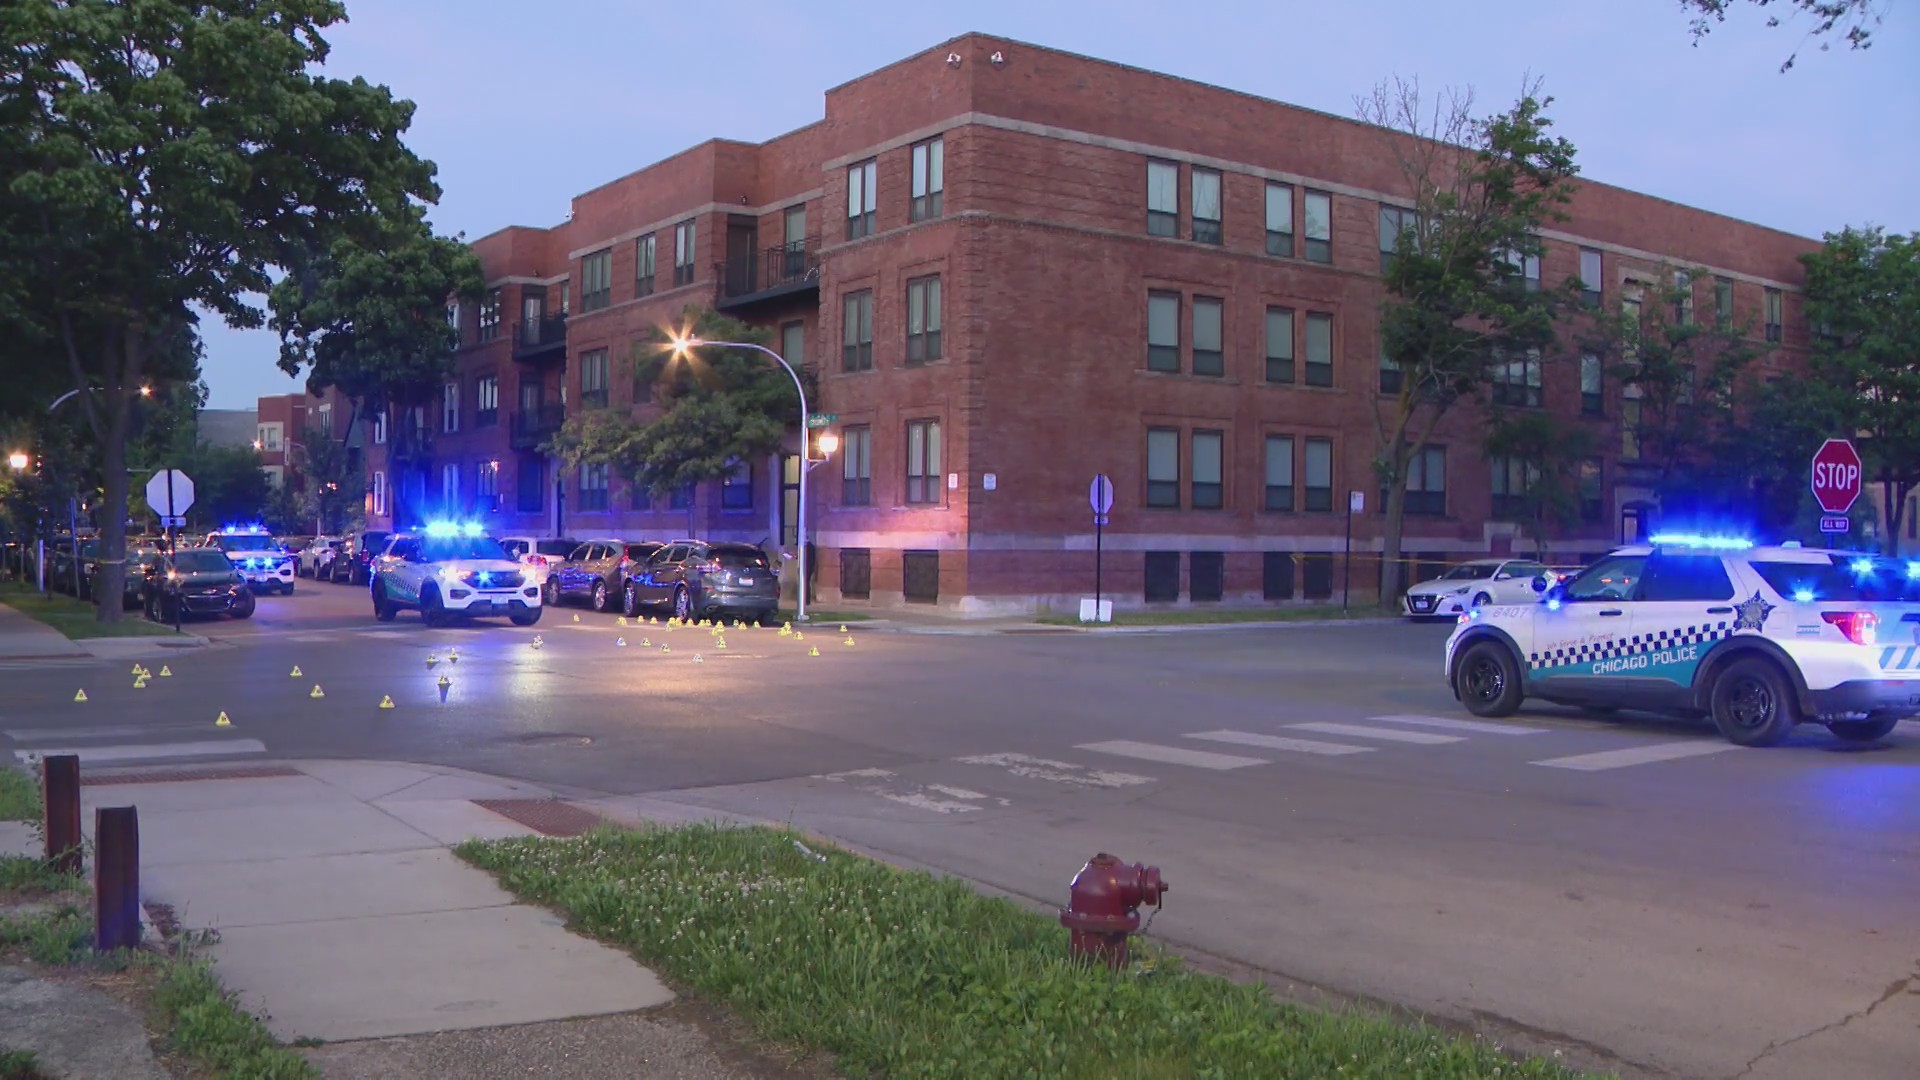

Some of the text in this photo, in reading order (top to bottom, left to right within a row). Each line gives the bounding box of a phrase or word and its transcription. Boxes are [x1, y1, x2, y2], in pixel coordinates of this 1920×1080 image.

[1816, 462, 1857, 490] STOP
[1592, 646, 1698, 674] CHICAGO POLICE
